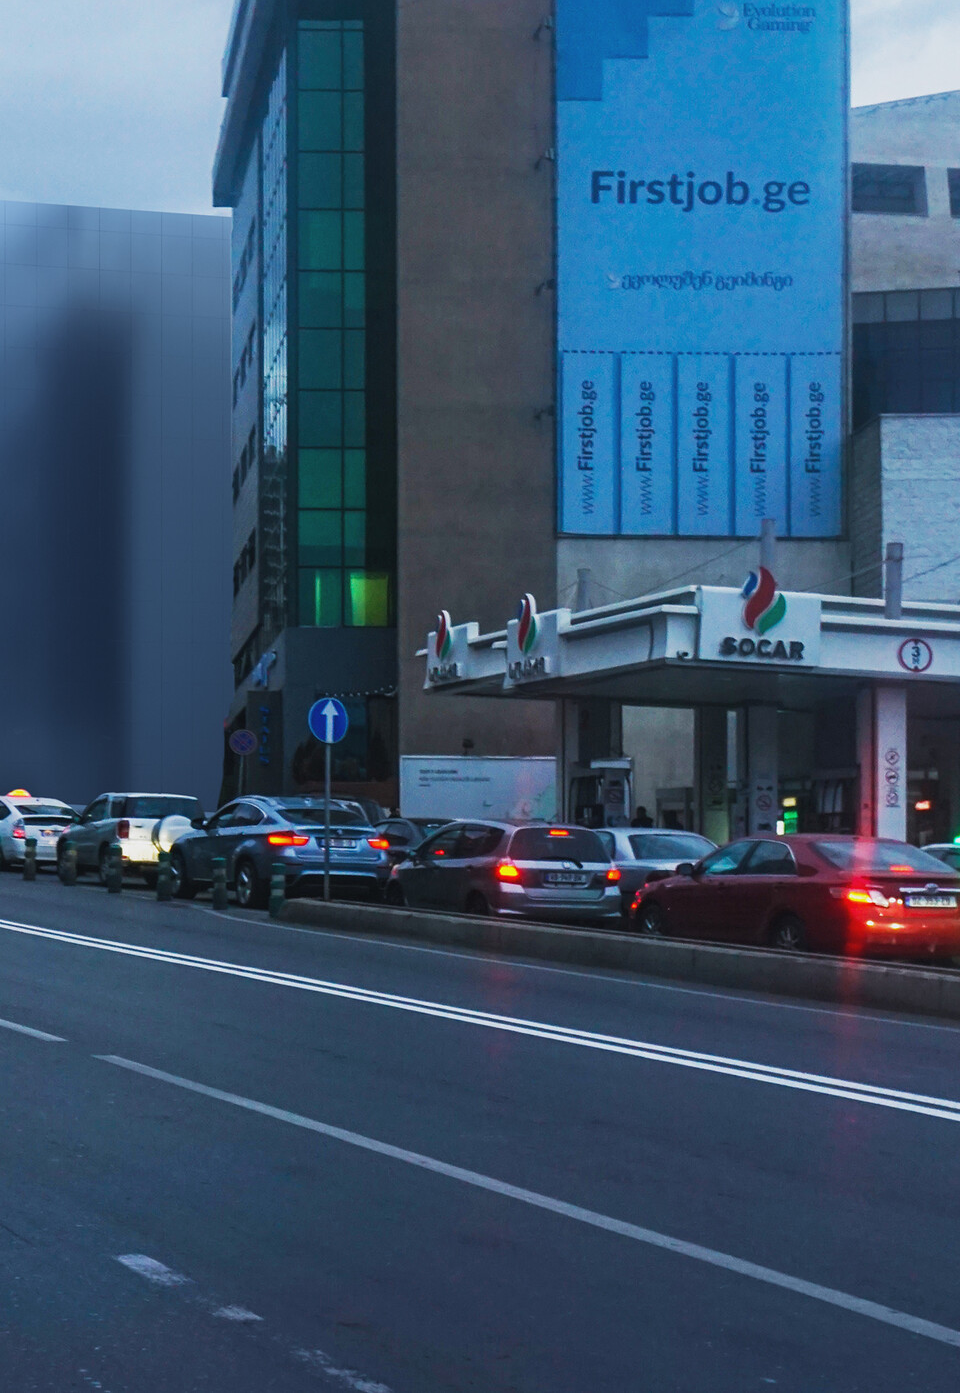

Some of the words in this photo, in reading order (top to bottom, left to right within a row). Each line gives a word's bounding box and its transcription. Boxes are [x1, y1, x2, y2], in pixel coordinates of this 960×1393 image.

[743, 3, 816, 17] Evolution
[747, 17, 813, 34] Gaming
[590, 170, 811, 212] Firstjob.ge
[577, 379, 598, 515] www.Firstjob.ge
[635, 381, 656, 516] www.Firstjob.ge
[692, 381, 713, 517] www.Firstjob.ge
[750, 382, 770, 517] www.Firstjob.ge
[805, 381, 825, 518] www.Firstjob.ge
[719, 636, 805, 661] SOCAR
